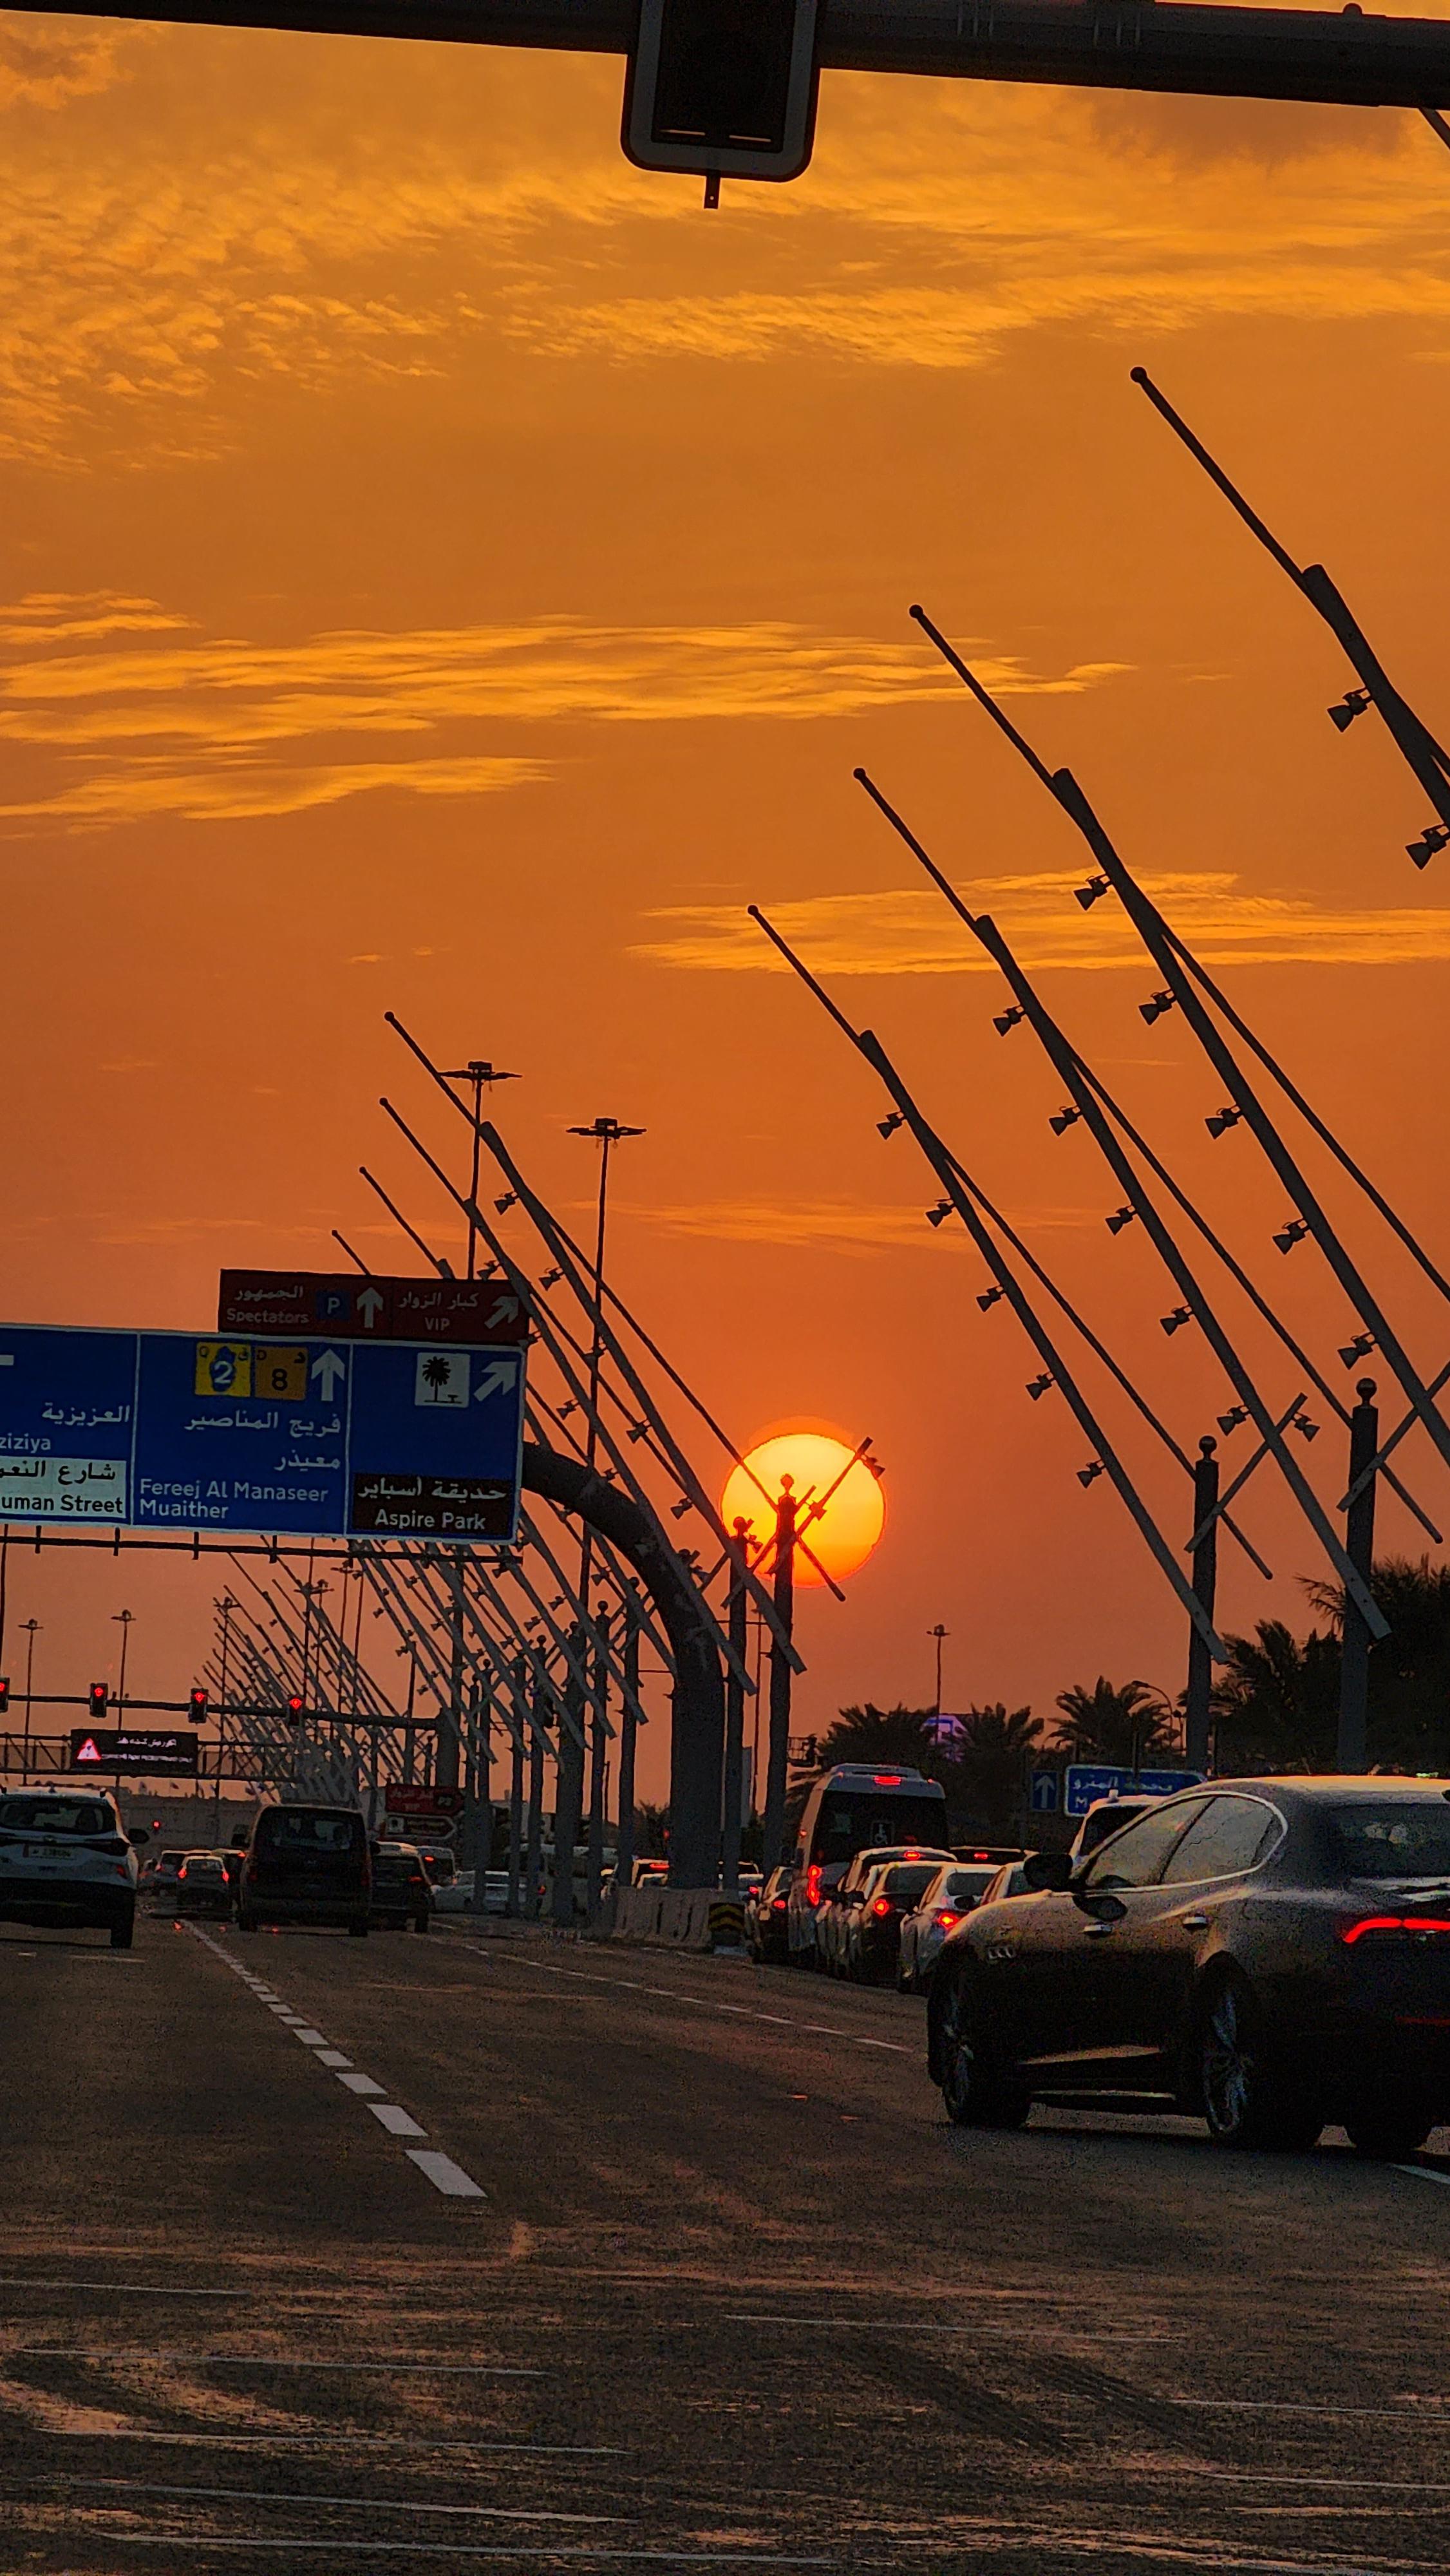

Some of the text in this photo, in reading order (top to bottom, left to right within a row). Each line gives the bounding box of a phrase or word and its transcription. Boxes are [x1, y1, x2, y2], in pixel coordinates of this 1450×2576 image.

[234, 1285, 304, 1302] الجمهور
[398, 1291, 479, 1311] كبار الزوار
[226, 1308, 310, 1324] Spectators
[327, 1296, 341, 1314] P
[424, 1317, 451, 1331] VIP
[214, 1360, 232, 1384] 2
[272, 1368, 288, 1391] 8
[41, 1401, 130, 1426] العزيزية
[184, 1410, 341, 1438] فريج المناصير
[274, 1450, 341, 1472] معيذر
[58, 1463, 115, 1485] شارع
[140, 1478, 329, 1502] Fereej Al Manaseer
[431, 1480, 507, 1504] حديقة
[61, 1494, 122, 1513] Street
[140, 1498, 229, 1519] Muaither
[374, 1508, 486, 1530] Aspire Park
